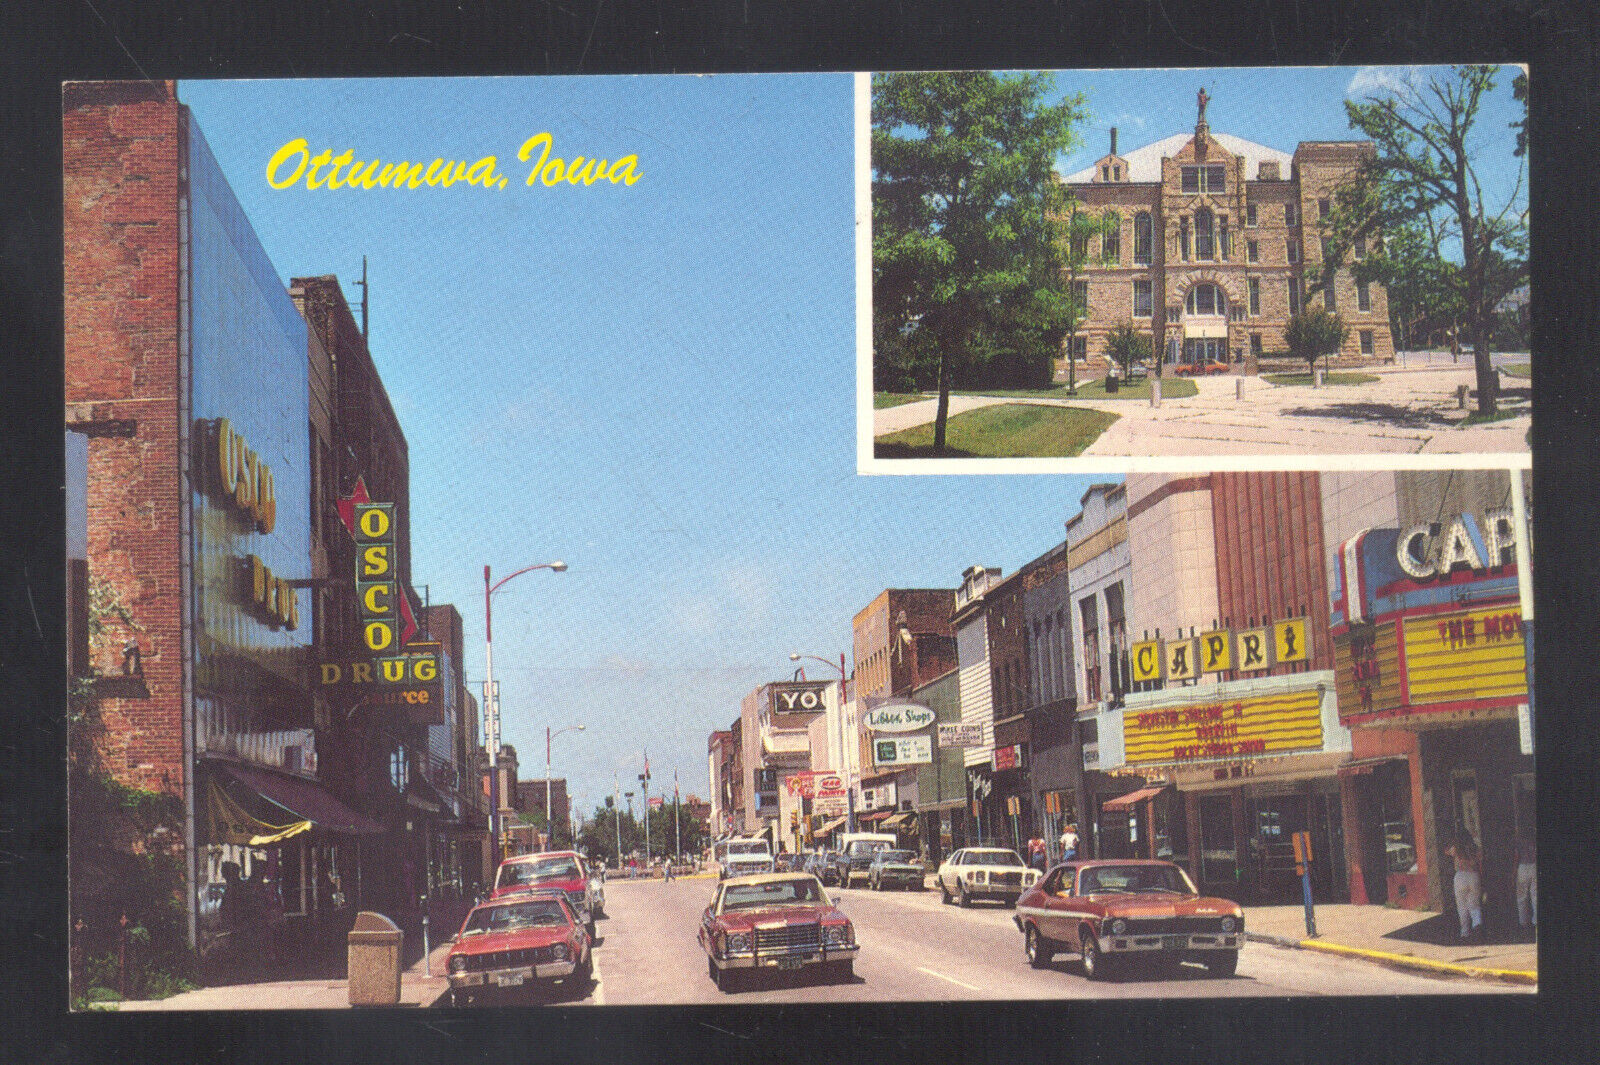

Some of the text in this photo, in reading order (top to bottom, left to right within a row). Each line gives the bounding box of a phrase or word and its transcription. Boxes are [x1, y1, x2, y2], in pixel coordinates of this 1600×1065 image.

[360, 508, 392, 651] OSCO
[320, 659, 437, 685] DRUG
[1136, 623, 1298, 677] CAPRI
